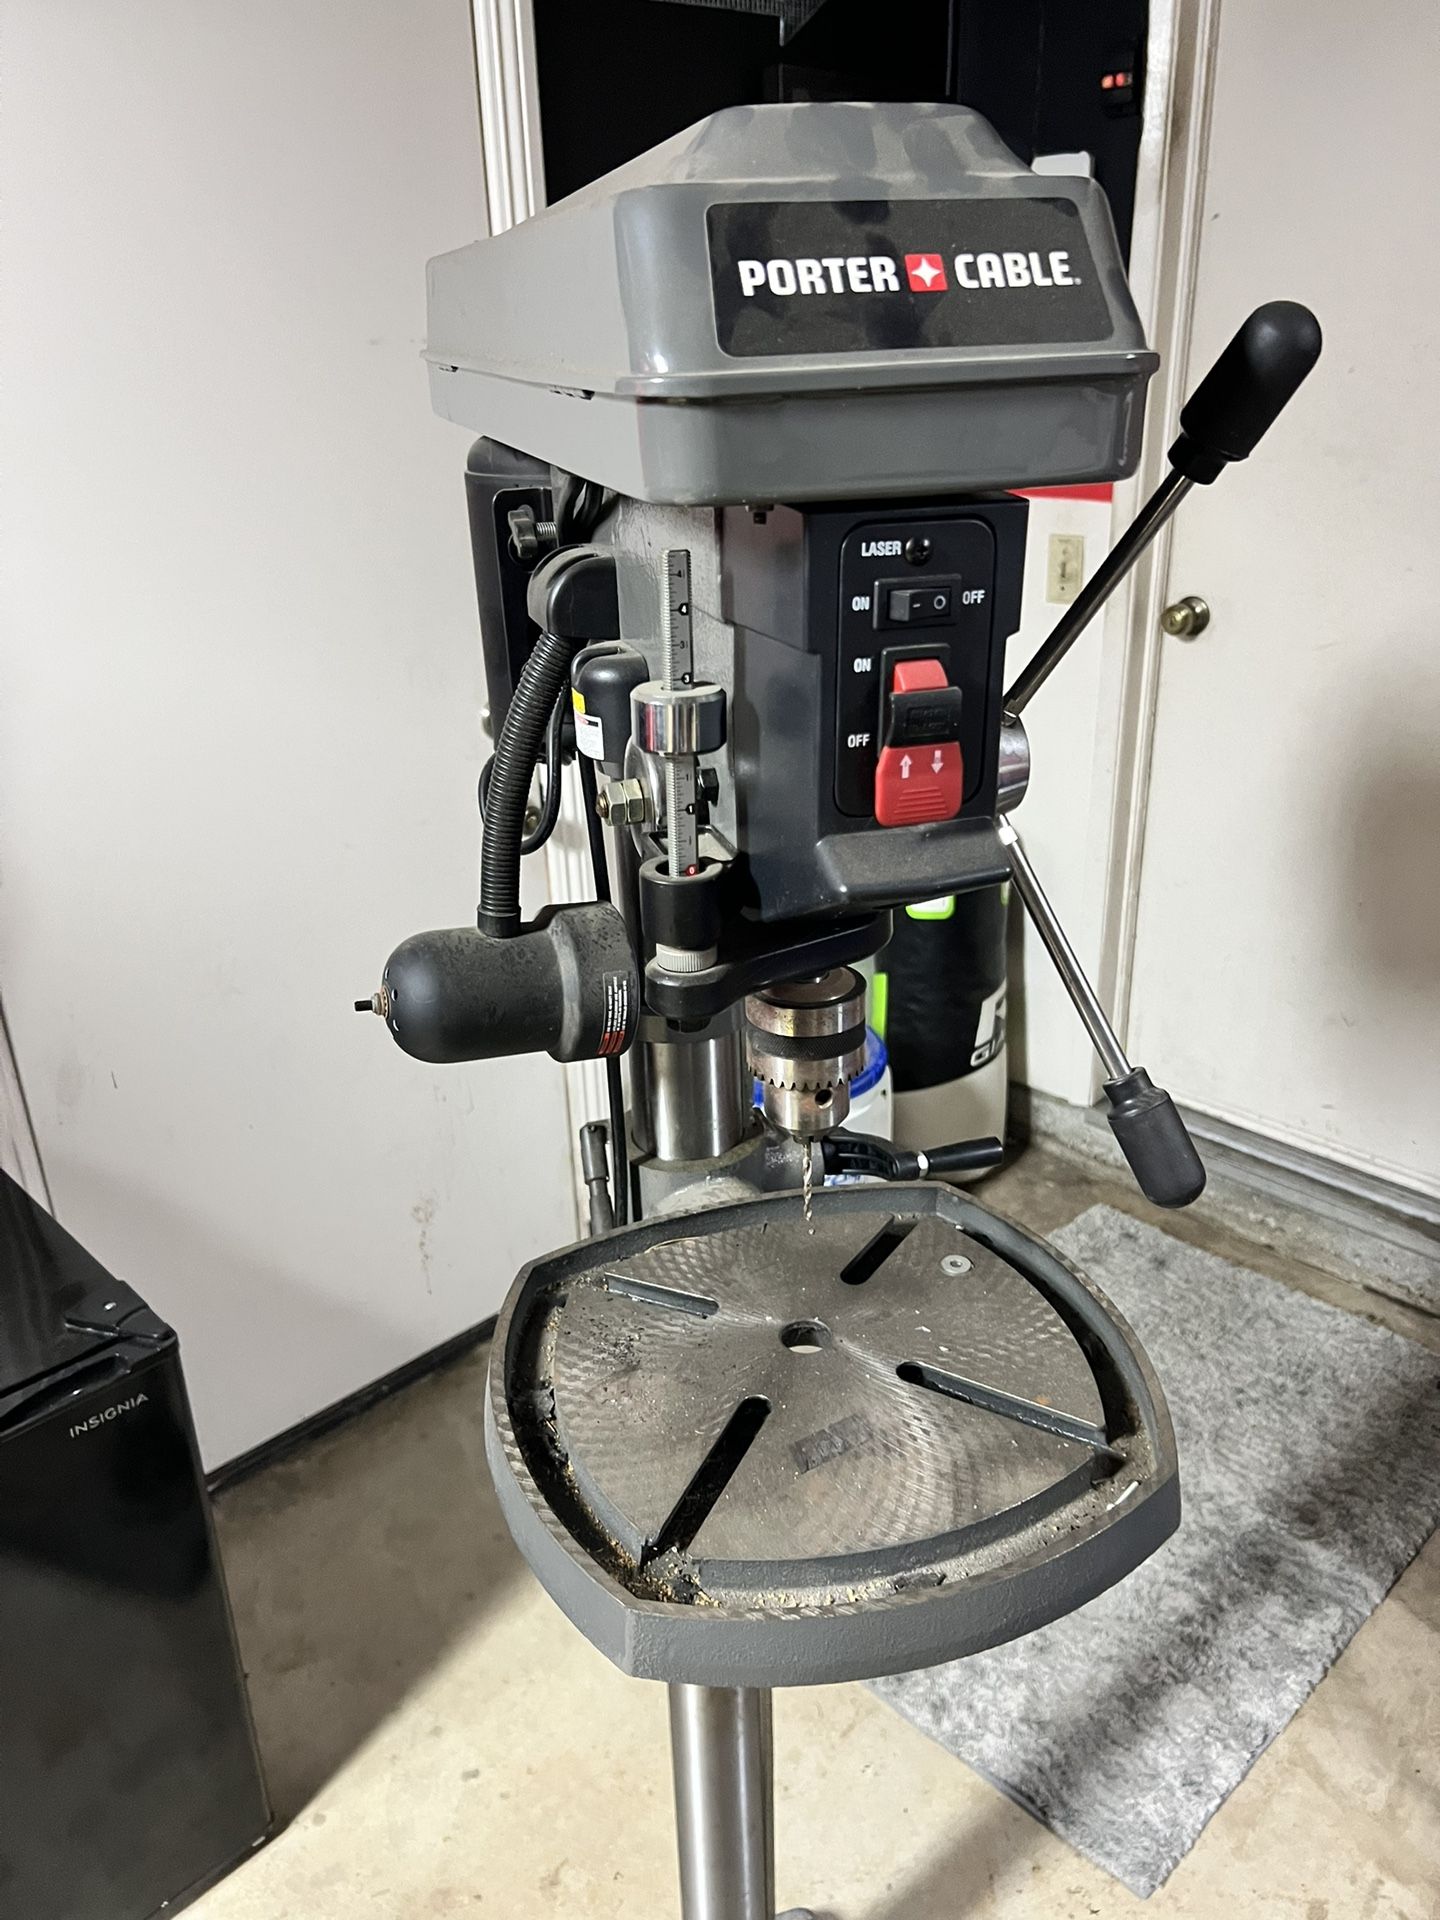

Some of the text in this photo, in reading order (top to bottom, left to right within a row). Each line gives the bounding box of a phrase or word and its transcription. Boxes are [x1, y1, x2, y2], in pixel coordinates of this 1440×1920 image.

[737, 255, 900, 297] PORTER
[861, 540, 902, 557] LASER
[852, 590, 985, 612] ON OFF
[853, 657, 872, 673] ON
[847, 733, 870, 749] OFF
[69, 1393, 149, 1438] INSIGNIA
